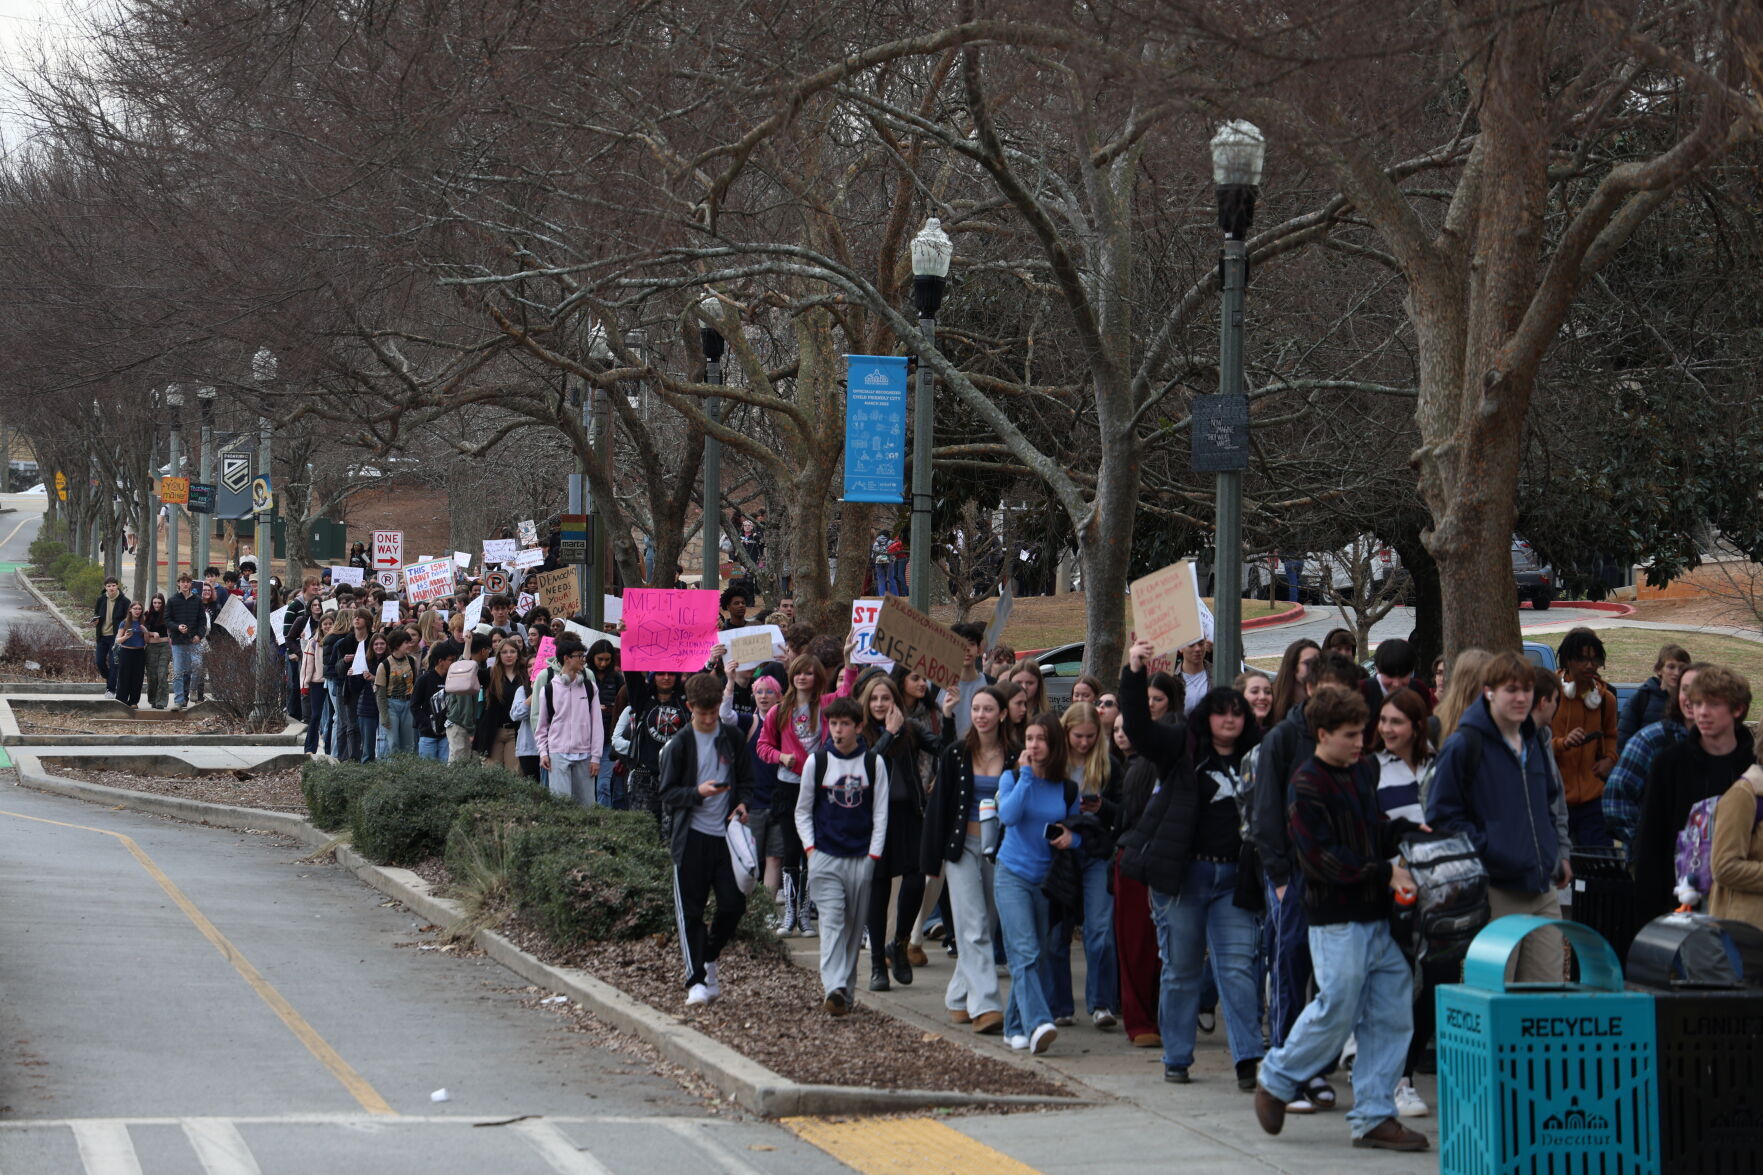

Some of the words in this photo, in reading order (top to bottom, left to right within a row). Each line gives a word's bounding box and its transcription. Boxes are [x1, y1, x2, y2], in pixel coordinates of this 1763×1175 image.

[377, 533, 399, 544] ONE
[377, 545, 399, 554] WAY
[407, 565, 426, 576] THIS
[410, 571, 430, 585] ABOUT
[429, 577, 447, 588] ABOUT
[545, 582, 572, 596] NEEDS
[412, 583, 453, 600] HUMANITY
[627, 591, 675, 611] MELT
[678, 607, 697, 626] ICE
[853, 606, 879, 623] ST
[672, 628, 693, 641] STOP
[857, 632, 879, 656] IC
[872, 627, 917, 667] RISE
[913, 654, 960, 687] ABOVE
[1446, 1007, 1482, 1034] RECYCLE
[1521, 1016, 1624, 1037] RECYCLE
[1541, 1133, 1611, 1146] Decatur
